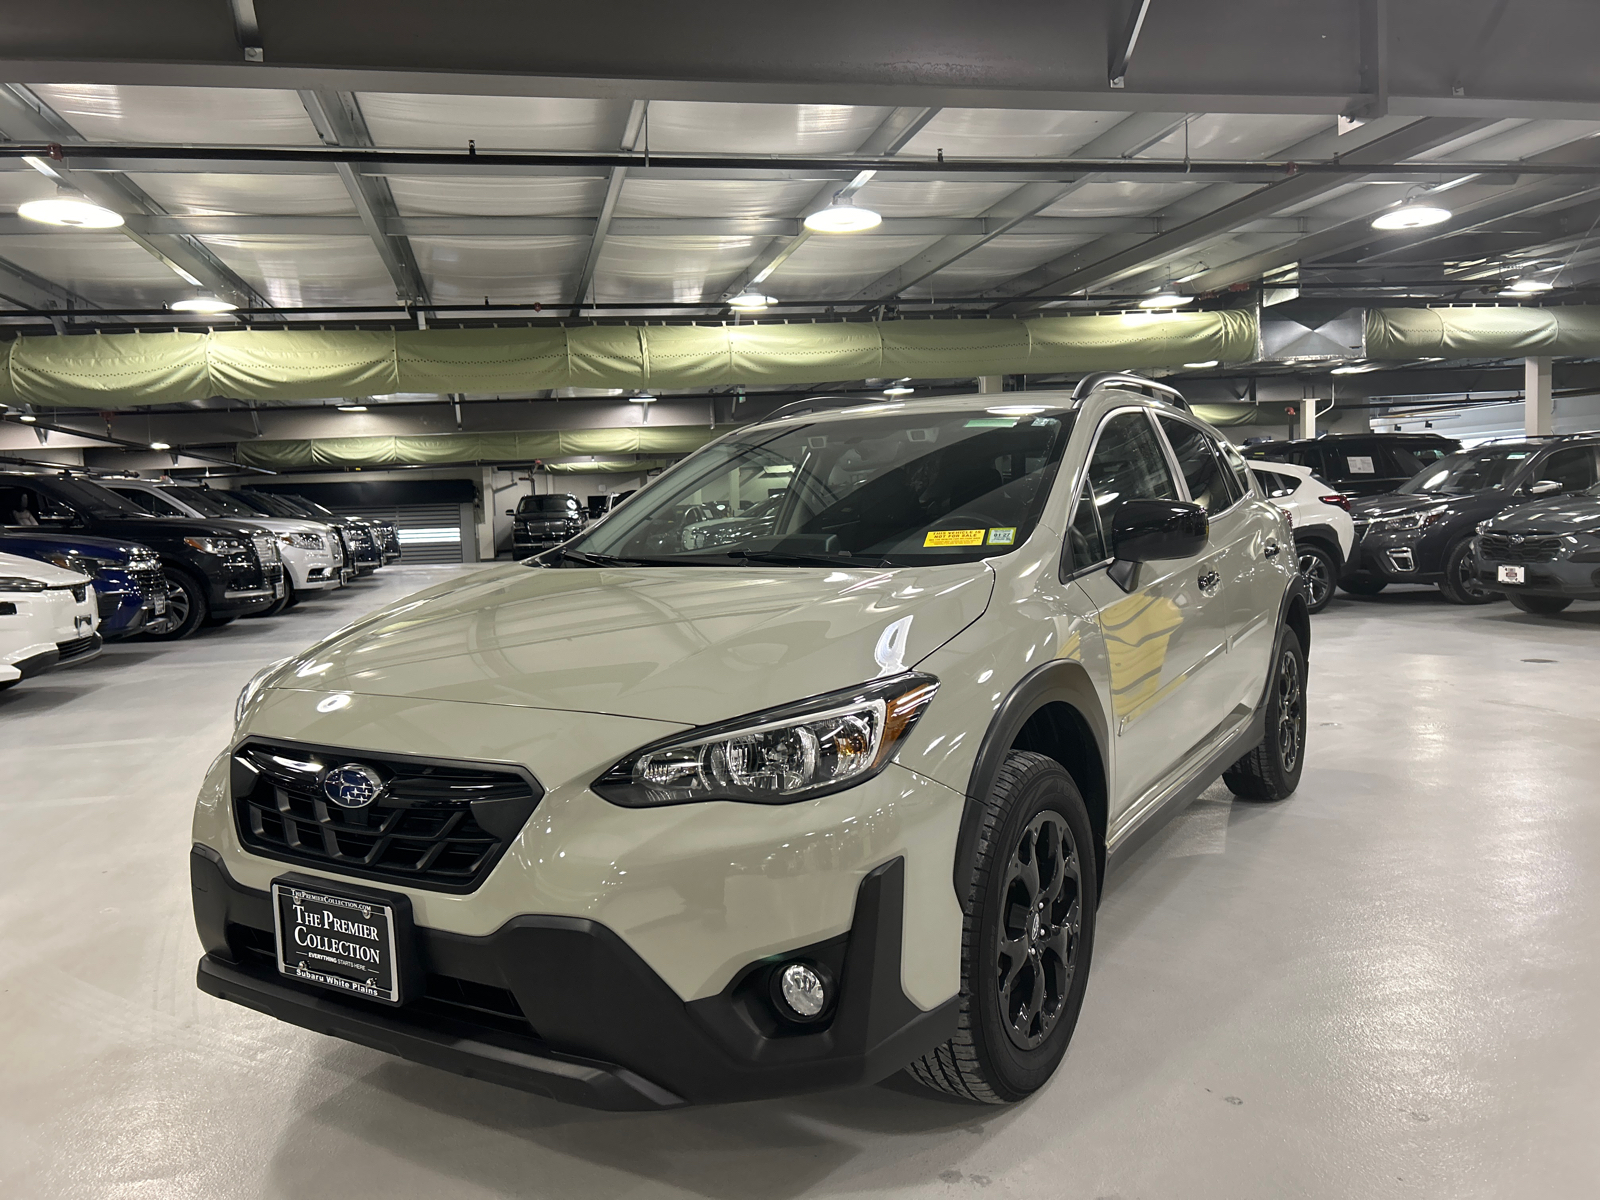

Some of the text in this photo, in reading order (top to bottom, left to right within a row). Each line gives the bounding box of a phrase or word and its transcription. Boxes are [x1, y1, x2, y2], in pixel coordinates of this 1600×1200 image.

[292, 904, 379, 941] THE PREMIER
[294, 925, 380, 964] COLLECTION
[308, 952, 367, 972] EVERYTHING STARTS HERE.
[296, 969, 378, 996] Subaru White Plains
